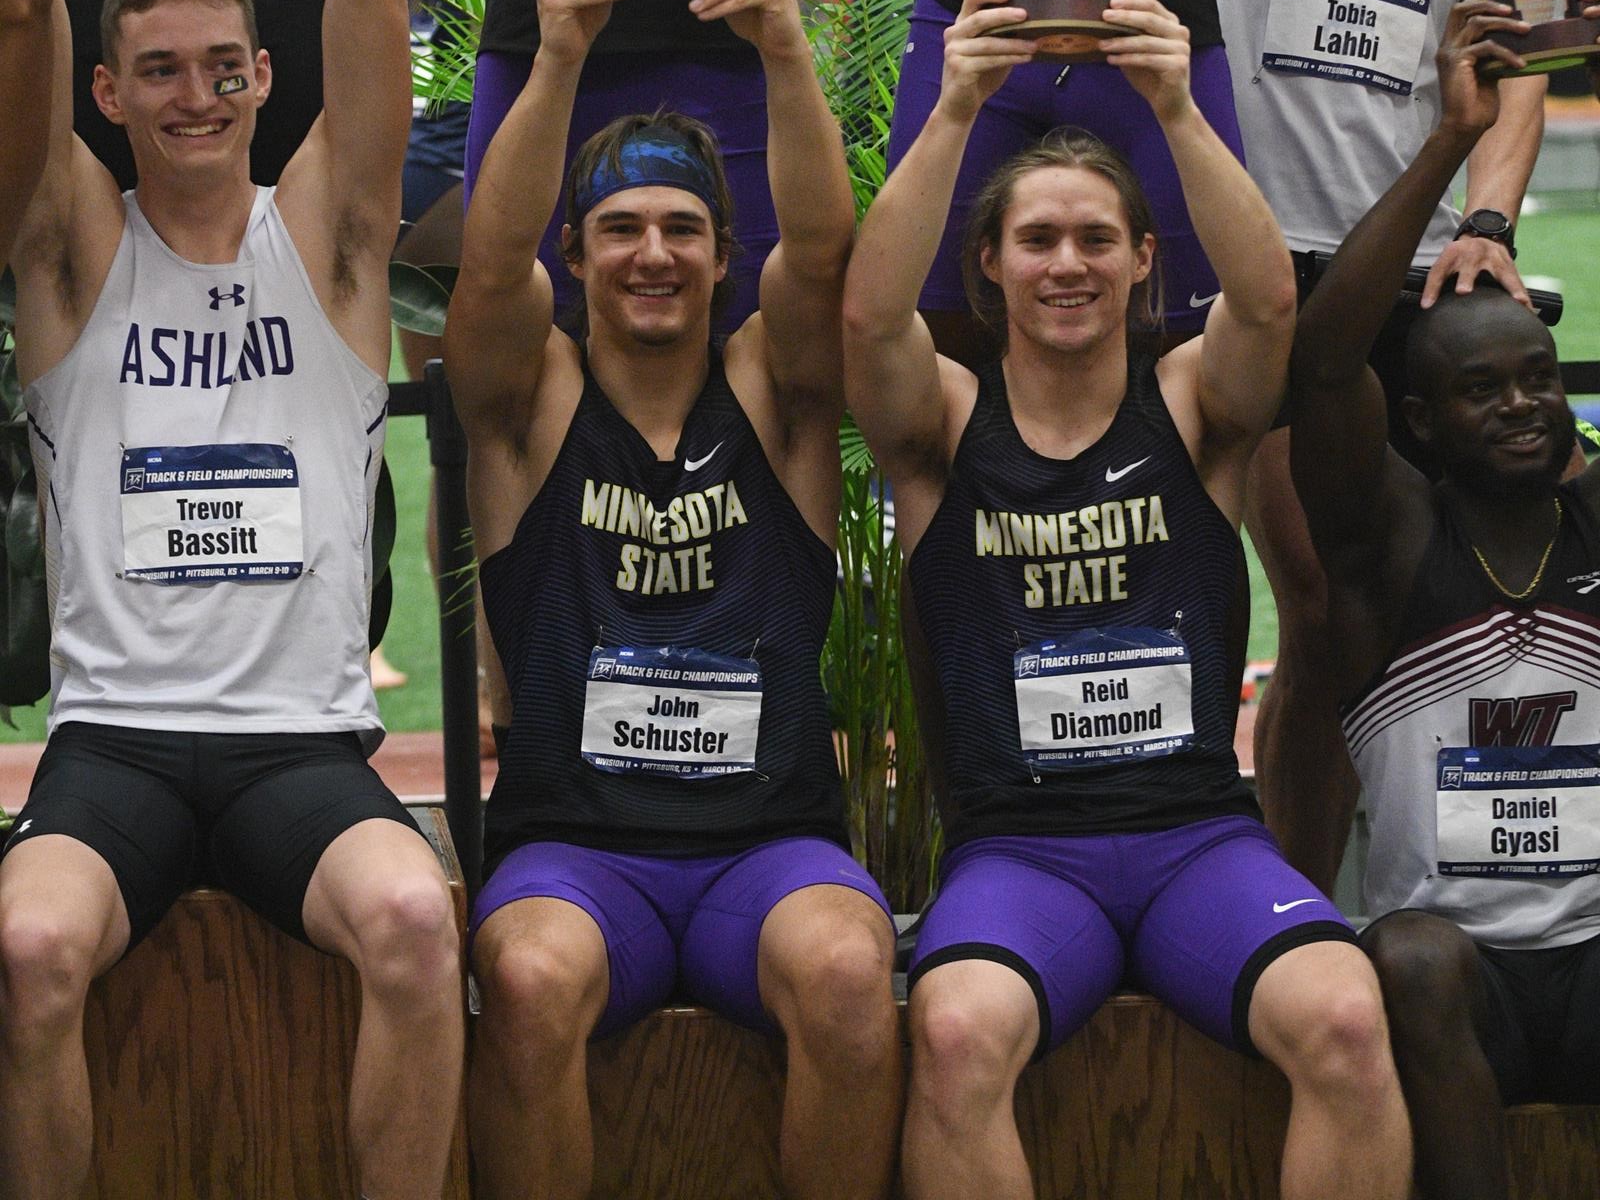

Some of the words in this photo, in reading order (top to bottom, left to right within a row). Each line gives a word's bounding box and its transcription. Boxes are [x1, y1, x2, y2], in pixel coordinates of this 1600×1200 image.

[1312, 25, 1380, 62] Lahbi
[1274, 58, 1303, 67] DIVISION
[1355, 70, 1365, 79] KS
[1371, 74, 1390, 86] MARCH
[145, 472, 177, 484] TRACK
[177, 471, 185, 482] &
[186, 470, 212, 481] FIELD
[214, 469, 294, 481] CHAMPIONSHIPS
[176, 498, 244, 521] Trevor
[580, 478, 750, 545] MINNESOTA
[975, 495, 1170, 557] MINNESOTA
[168, 527, 258, 557] Bassitt
[185, 568, 226, 578] PITTSBURG,
[227, 568, 238, 576] KS
[248, 567, 273, 575] MARCH
[274, 566, 289, 575] 9-10
[616, 543, 715, 595] STATE
[1023, 554, 1128, 609] STATE
[1040, 656, 1072, 669] TRACK
[1071, 655, 1079, 666] &
[1080, 653, 1105, 664] FIELD
[1107, 647, 1185, 663] CHAMPIONSHIPS
[615, 665, 646, 677] TRACK
[646, 667, 653, 678] &
[654, 669, 680, 680] FIELD
[682, 671, 758, 684] CHAMPIONSHIPS
[1082, 677, 1129, 704] Reid
[647, 694, 699, 719] John
[1469, 690, 1578, 747] WT
[1051, 702, 1162, 741] Diamond
[613, 720, 728, 754] Schuster
[1143, 741, 1167, 751] MARCH
[595, 758, 626, 768] DIVISION
[701, 766, 726, 774] MARCH
[1463, 771, 1493, 782] TRACK
[1494, 772, 1501, 781] &
[1502, 771, 1528, 781] FIELD
[1492, 796, 1557, 820] Daniel
[1491, 825, 1559, 857] Gyasi
